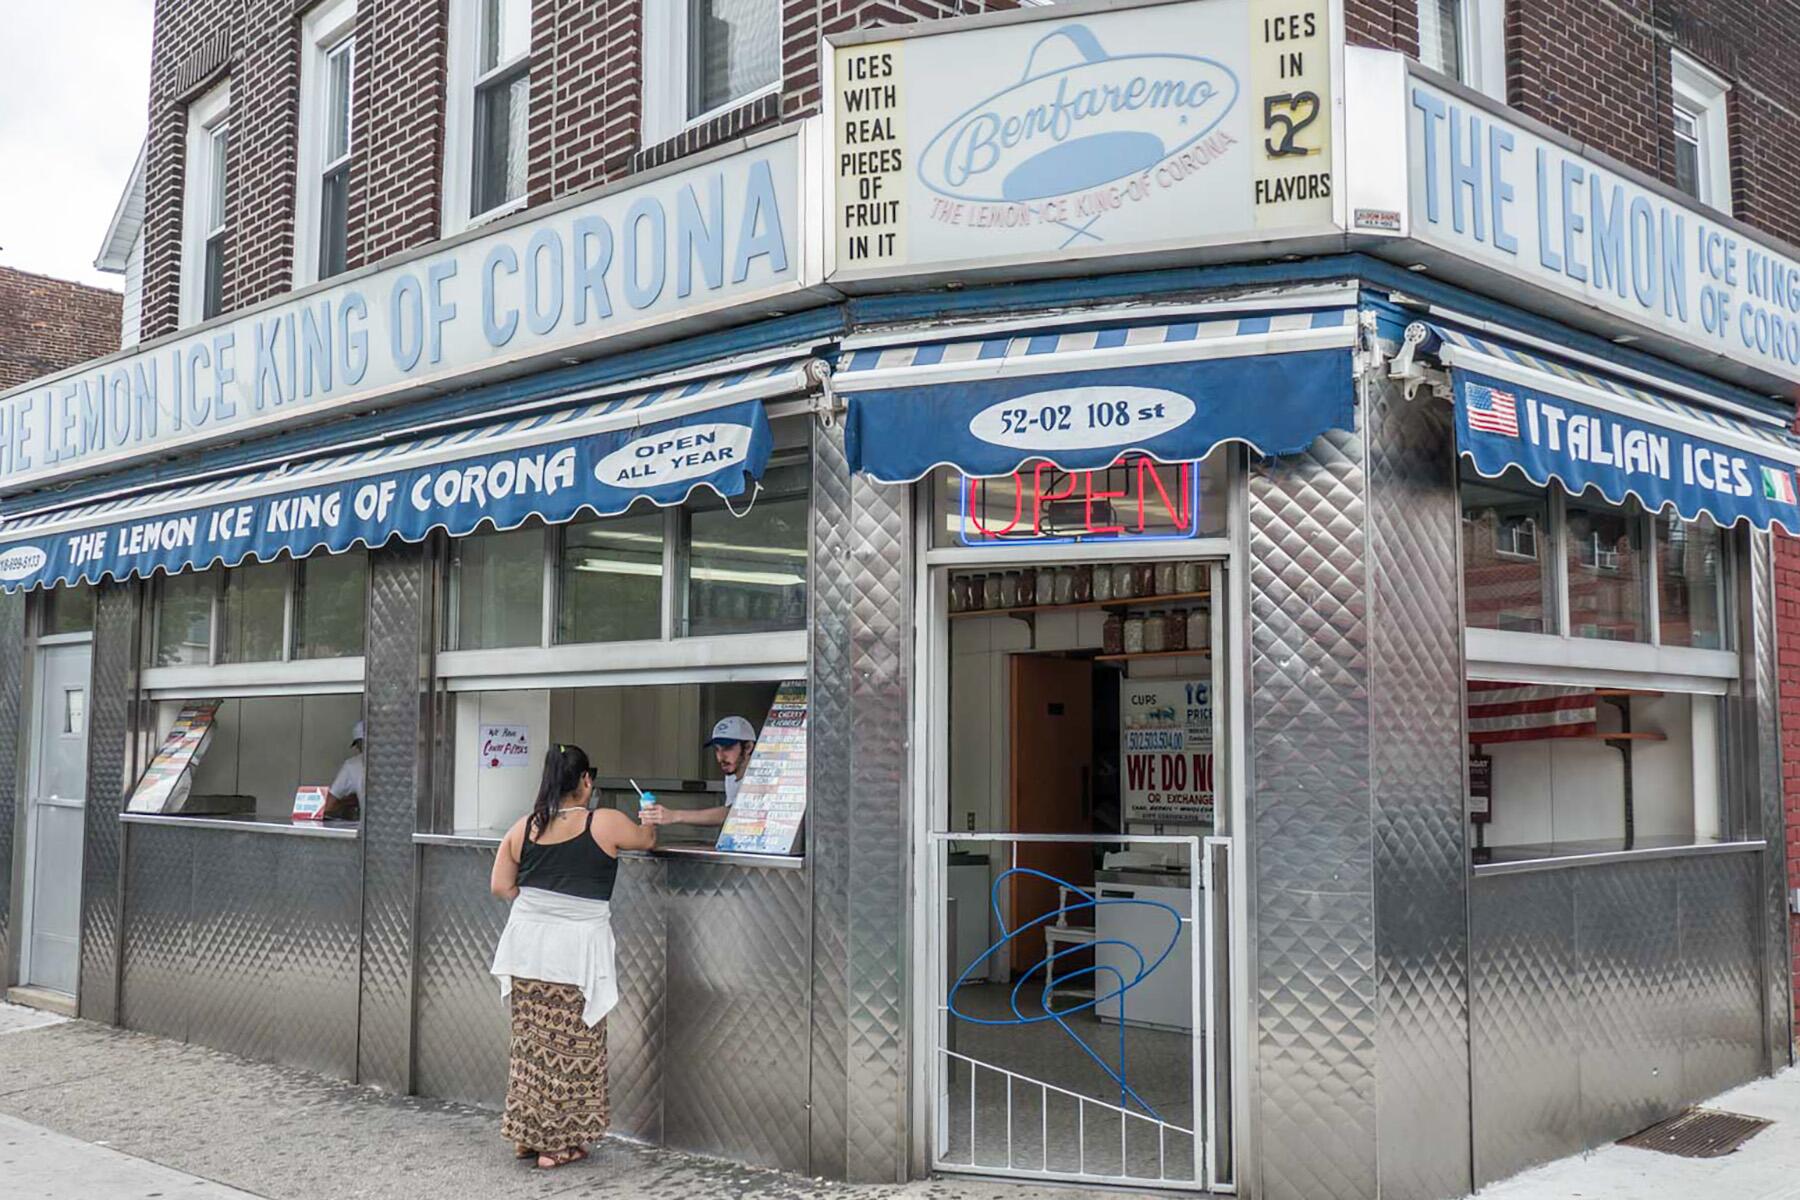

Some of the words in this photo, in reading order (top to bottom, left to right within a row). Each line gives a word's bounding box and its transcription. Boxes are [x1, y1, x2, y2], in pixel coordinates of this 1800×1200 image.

[1264, 13, 1316, 43] ICES
[847, 54, 893, 81] ICES
[1280, 52, 1303, 78] IN
[843, 84, 897, 113] WITH
[845, 117, 896, 144] REAL
[944, 77, 1219, 187] Benfaremo
[1263, 91, 1321, 157] 52
[841, 149, 902, 176] PIECES
[859, 177, 882, 200] OF
[929, 197, 961, 224] THE
[968, 204, 1030, 228] LEMON
[1039, 200, 1068, 224] ICE
[1075, 187, 1122, 218] KING
[1127, 173, 1151, 201] OF
[1156, 130, 1239, 188] CORONA
[1255, 173, 1331, 204] FLAVORS
[845, 201, 900, 228] FRUIT
[1413, 87, 1518, 255] THE
[1537, 146, 1688, 322] LEMON
[849, 236, 869, 260] IN
[878, 233, 897, 257] IT
[1698, 225, 1737, 287] ICE
[1746, 248, 1800, 313] KING
[44, 358, 158, 465] LEMON
[173, 332, 237, 431] ICE
[254, 291, 369, 411] KING
[391, 258, 457, 372] OF
[482, 159, 787, 347] CORONA
[1700, 284, 1730, 338] OF
[1740, 301, 1800, 366] CORO
[1001, 405, 1072, 434] 52-02
[1088, 401, 1130, 428] 108
[1138, 403, 1165, 420] st
[635, 431, 716, 458] OPEN
[1526, 398, 1670, 481] ITALIAN
[1683, 442, 1752, 497] ICES
[616, 465, 656, 482] ALL
[671, 447, 734, 469] YEAR
[68, 531, 106, 566] THE
[118, 515, 198, 557] LEMON
[208, 506, 253, 542] ICE
[267, 491, 341, 533] KING
[354, 479, 397, 523] OF
[411, 447, 576, 511] CORONA
[969, 456, 1190, 537] OPEN
[1131, 694, 1157, 706] CUPS
[1185, 682, 1213, 705] IC
[1127, 754, 1155, 791] WE
[1161, 754, 1187, 792] DO
[1148, 793, 1162, 804] OR
[1167, 794, 1213, 806] EXCHANGE
